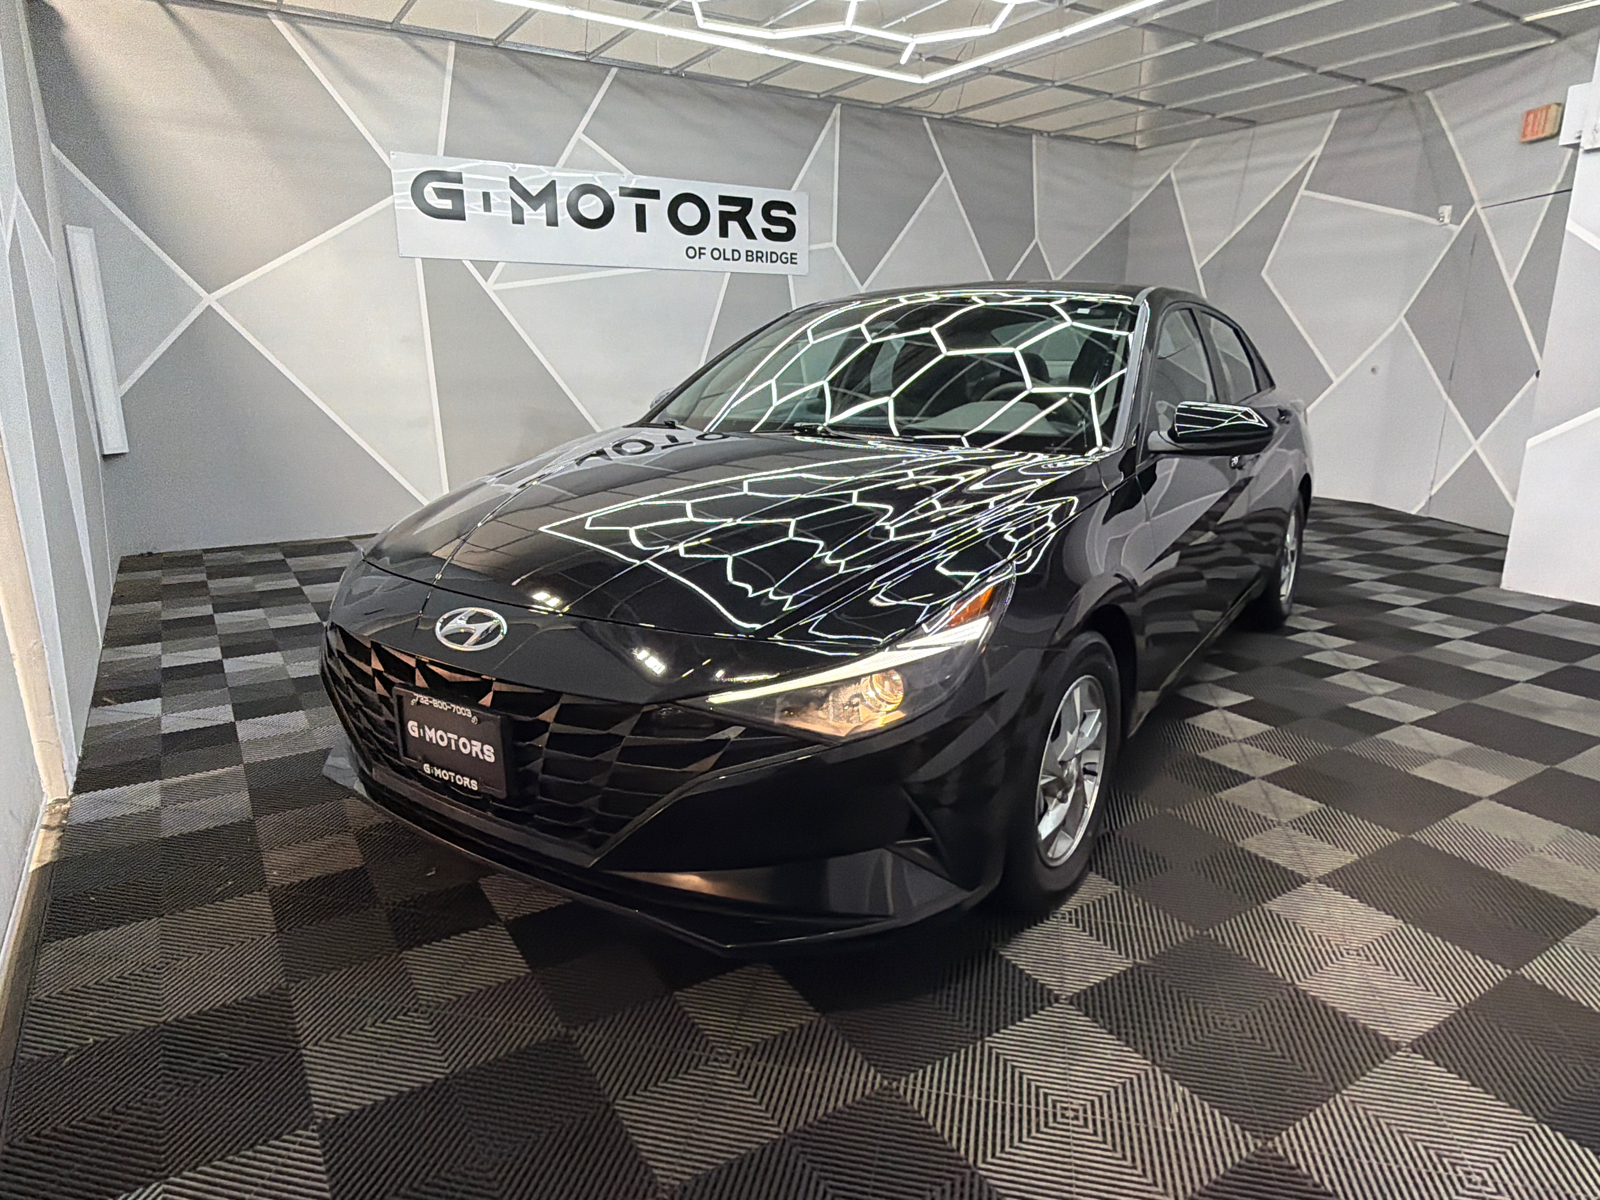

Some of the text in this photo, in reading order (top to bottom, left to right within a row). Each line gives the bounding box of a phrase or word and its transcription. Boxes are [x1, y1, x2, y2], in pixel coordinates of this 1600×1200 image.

[685, 246, 798, 265] OF OLD BRIDGE
